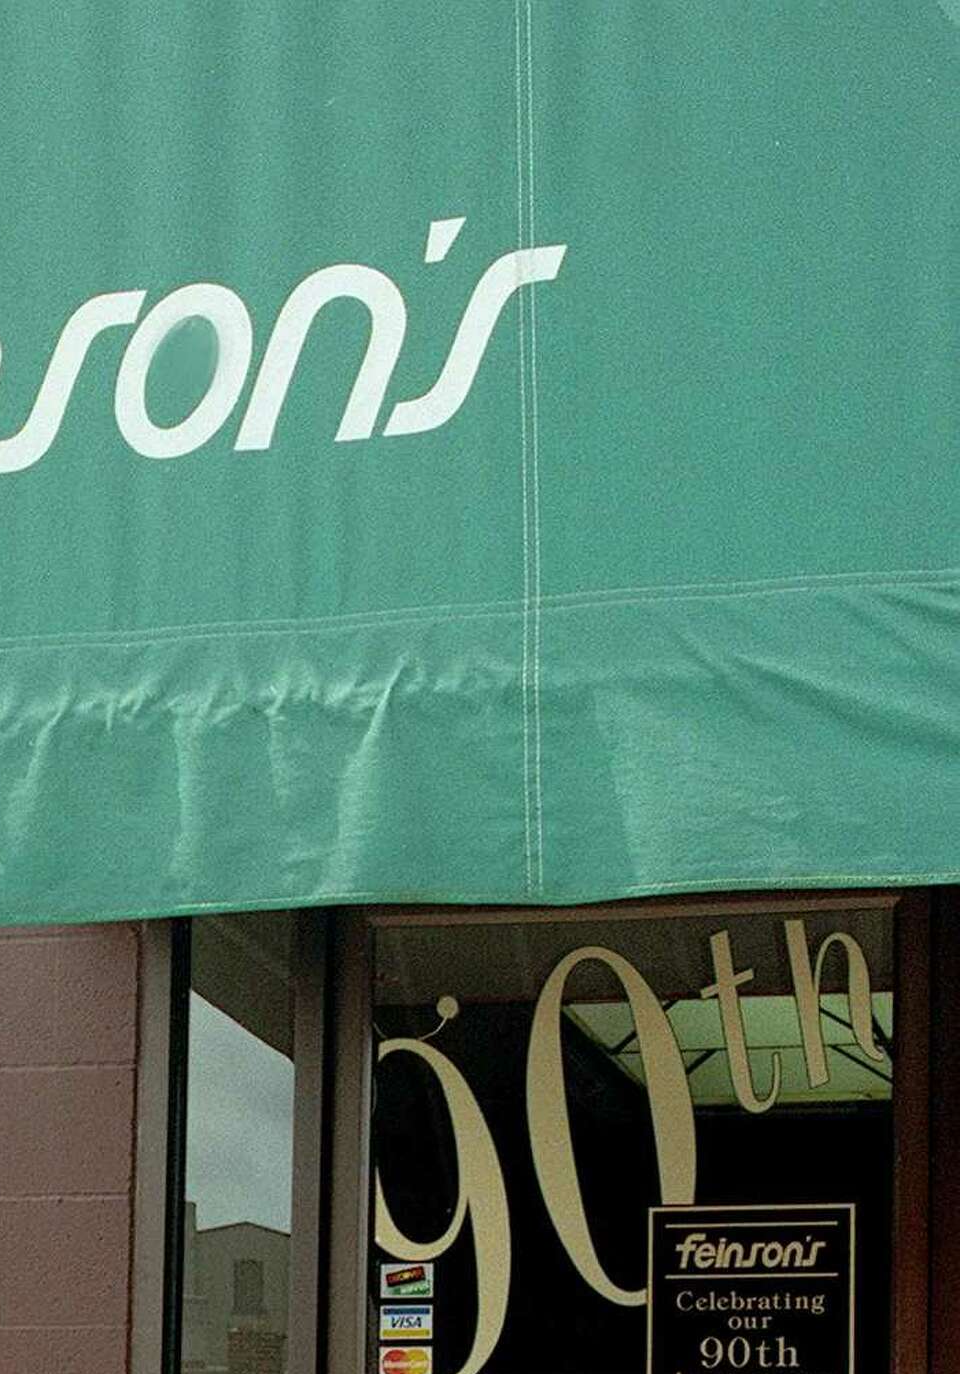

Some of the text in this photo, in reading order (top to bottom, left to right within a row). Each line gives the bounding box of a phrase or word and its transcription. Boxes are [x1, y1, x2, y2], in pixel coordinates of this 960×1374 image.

[675, 1233, 826, 1268] feinson's
[676, 1291, 826, 1315] Celebrating
[391, 1316, 422, 1328] VISA
[728, 1316, 772, 1329] our
[700, 1336, 800, 1369] 90th
